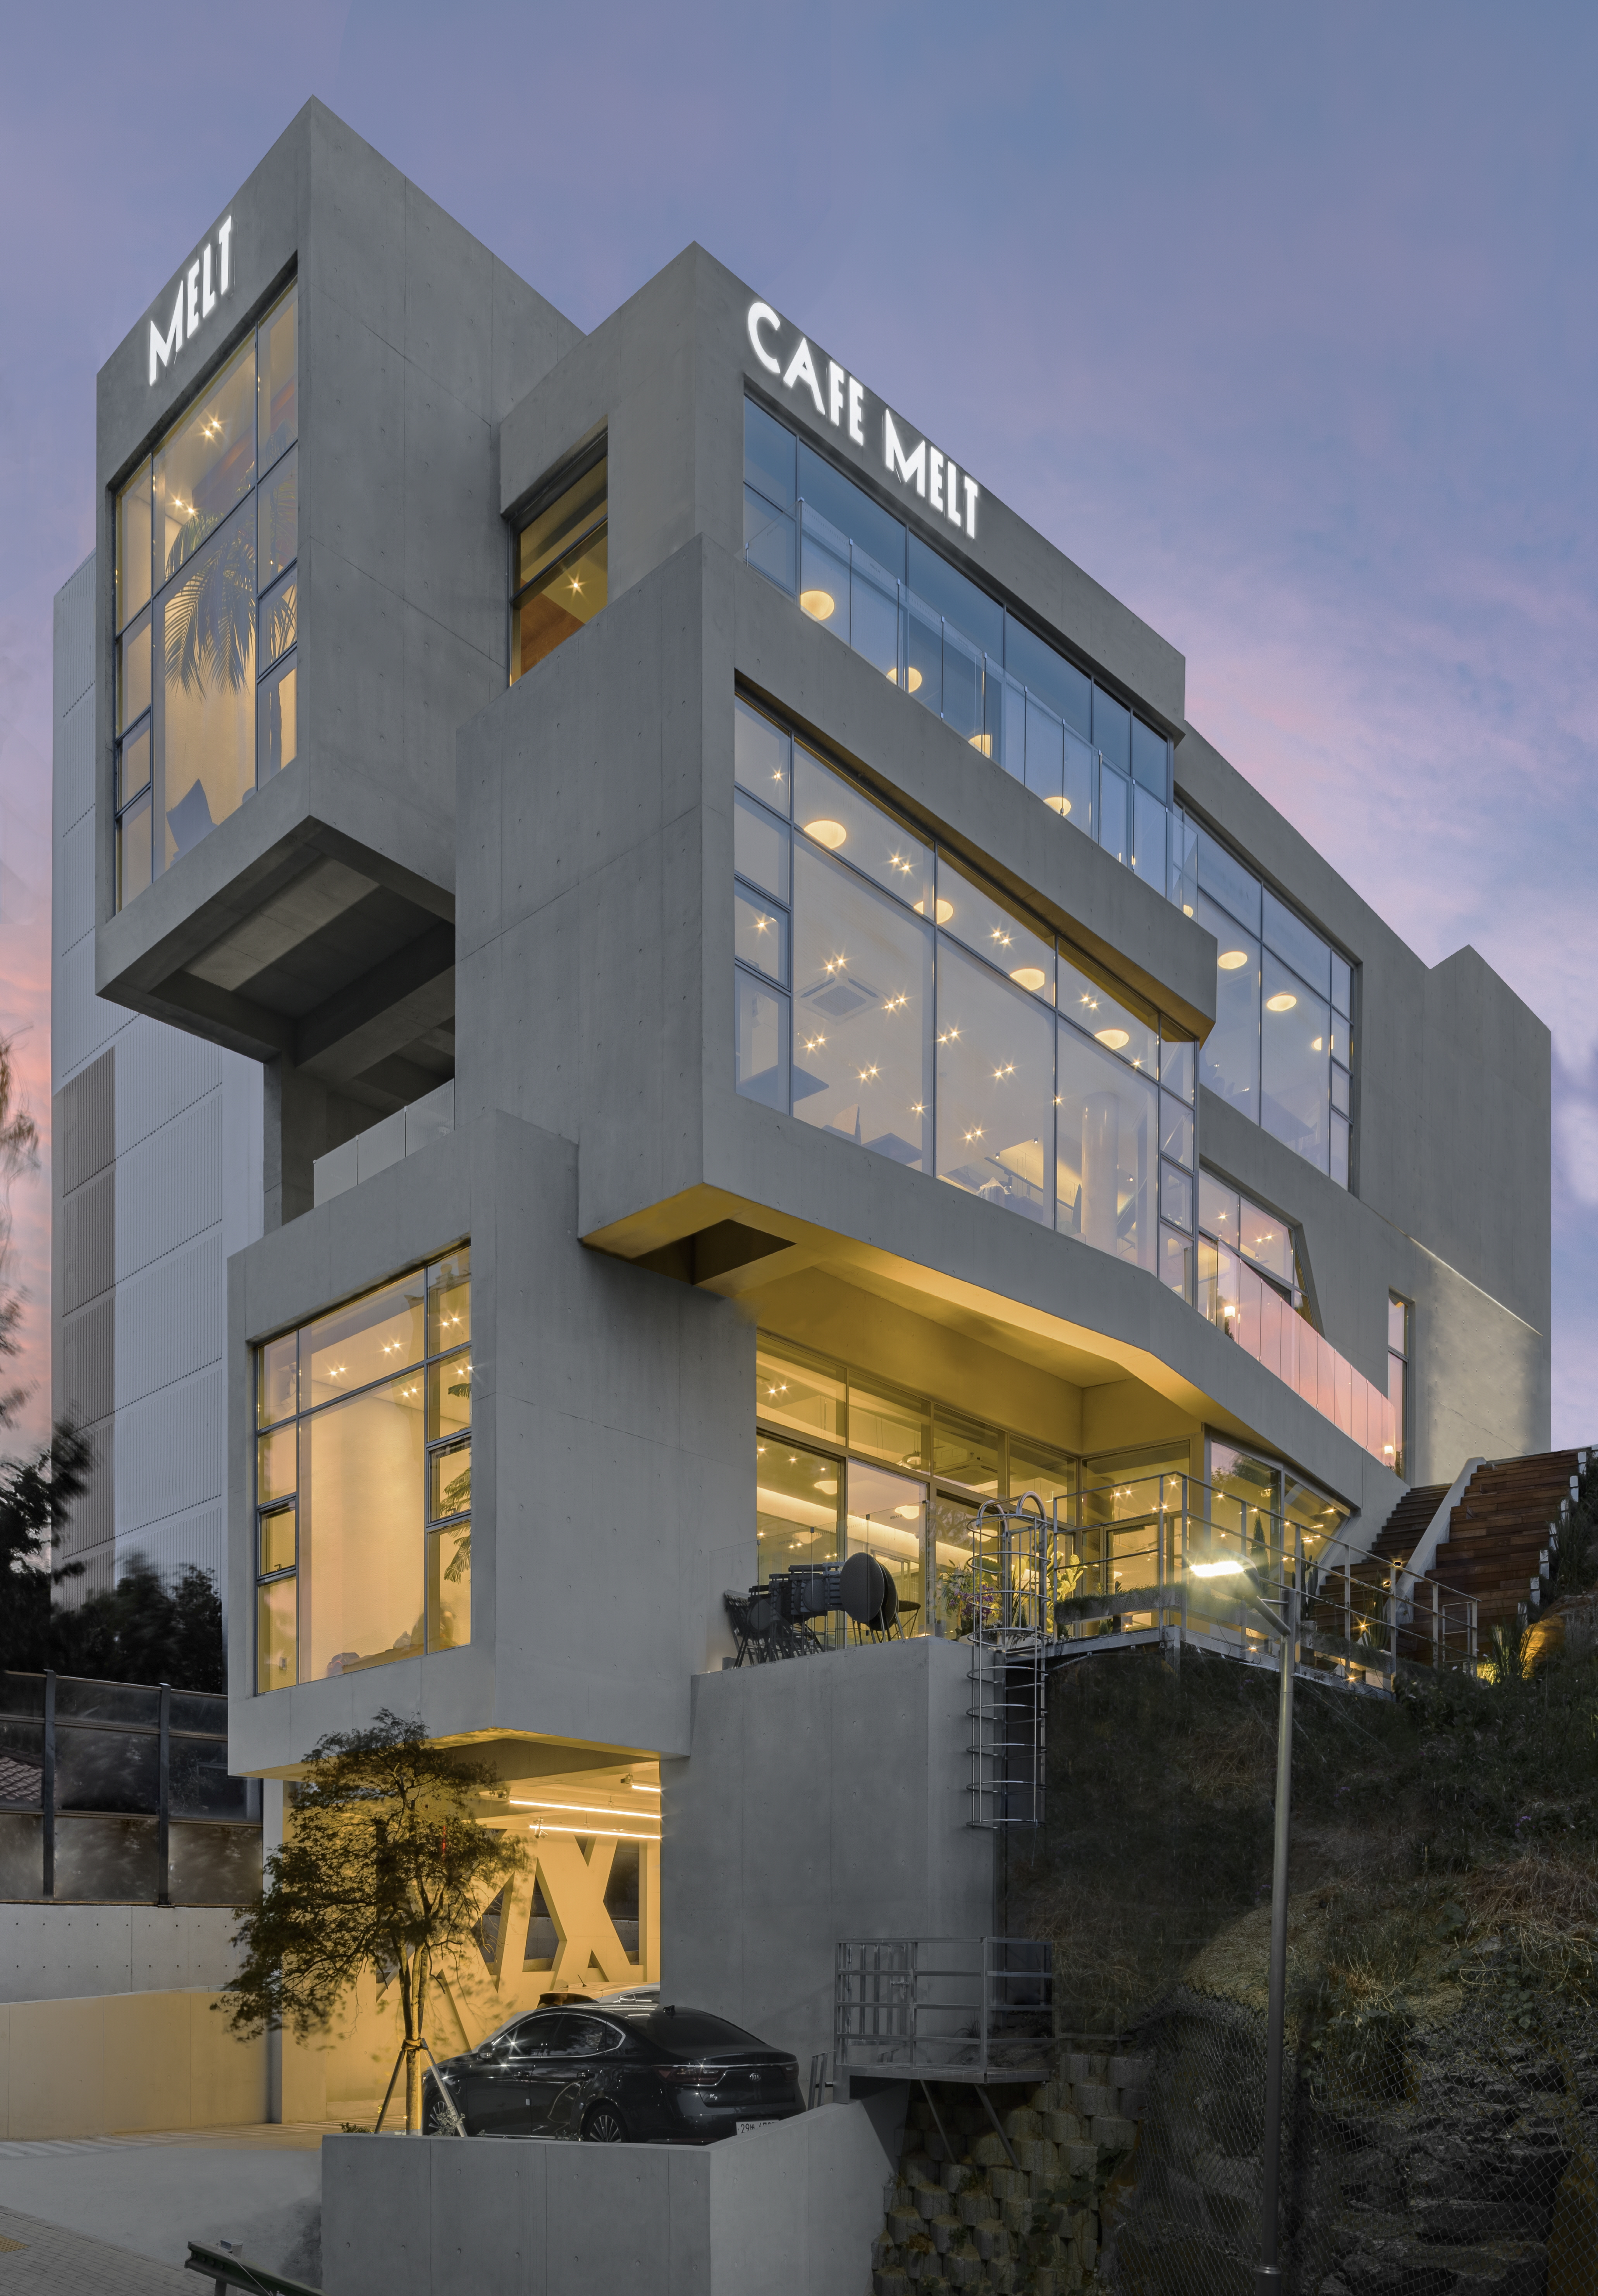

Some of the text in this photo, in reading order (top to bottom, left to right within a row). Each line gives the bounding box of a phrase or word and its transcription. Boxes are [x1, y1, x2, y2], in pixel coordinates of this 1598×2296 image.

[150, 215, 232, 386] MELT
[748, 302, 978, 539] CAFE MELT
